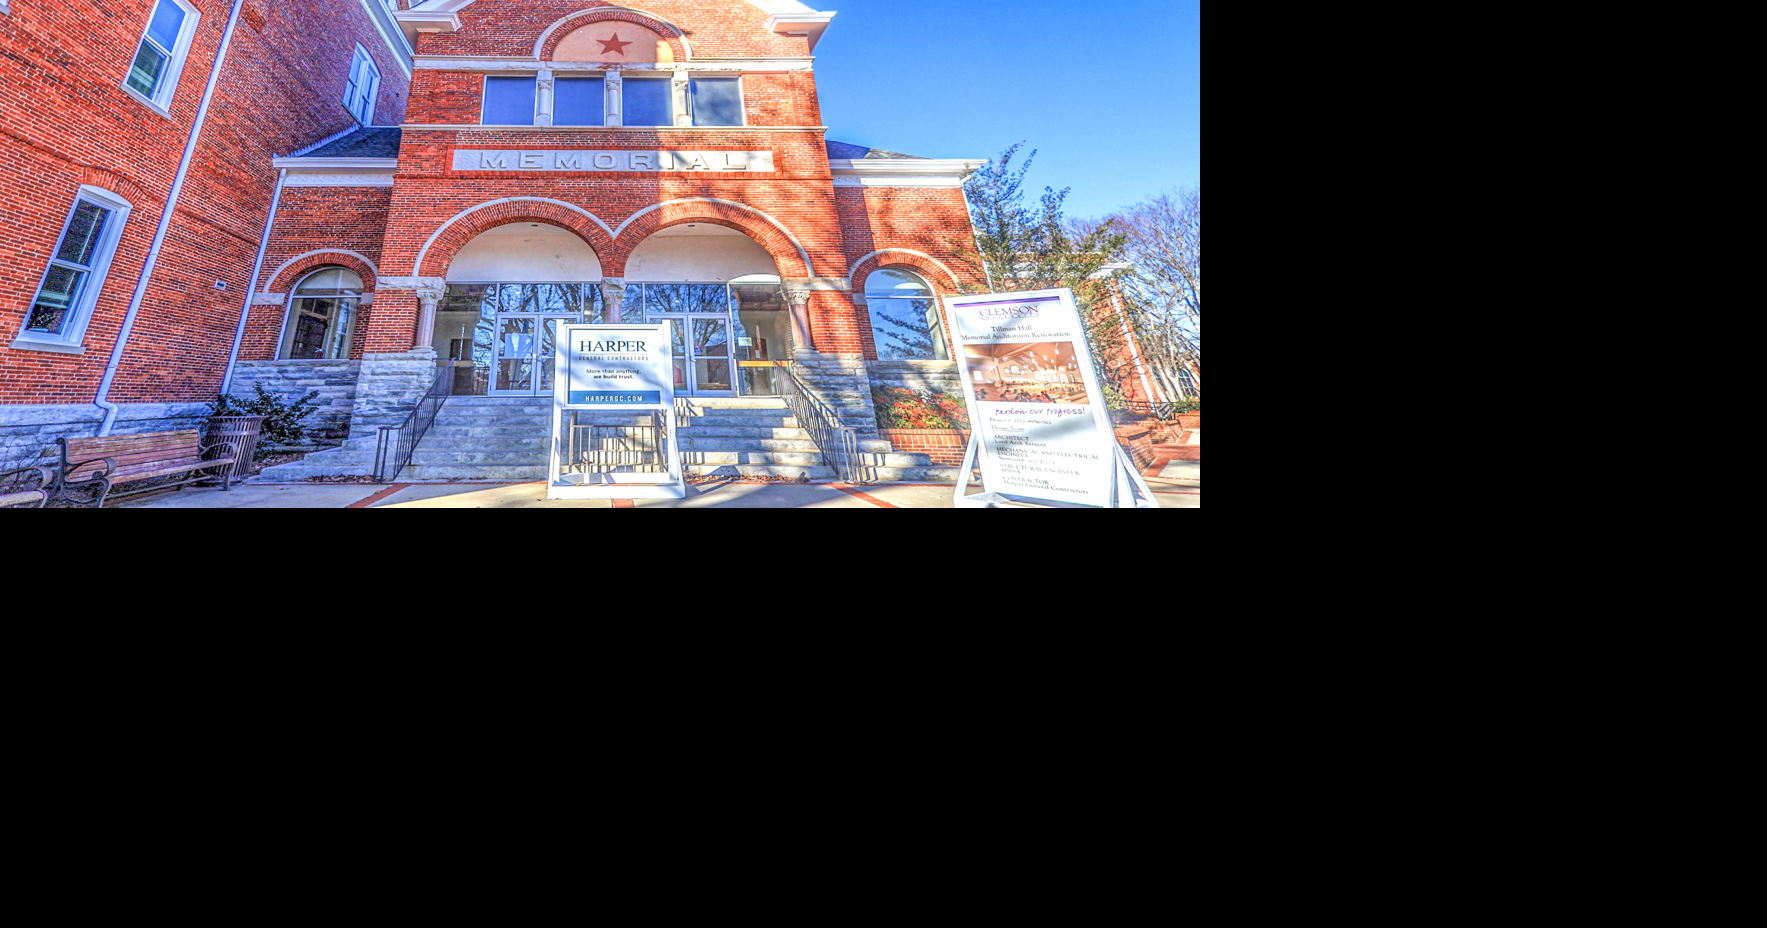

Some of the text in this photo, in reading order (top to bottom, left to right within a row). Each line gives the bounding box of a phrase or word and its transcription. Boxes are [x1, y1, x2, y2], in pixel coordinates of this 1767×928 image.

[480, 152, 747, 170] MEMORIAL
[979, 305, 1038, 317] CLEMSON
[580, 340, 647, 352] HARPER
[995, 446, 1038, 455] MECHANICAL
[1056, 451, 1100, 460] ELECTRICAL
[1000, 463, 1080, 476] STRUCTURAL ENGINEER
[1002, 475, 1049, 485] CONTRACTOR
[1050, 485, 1089, 494] Contractors
